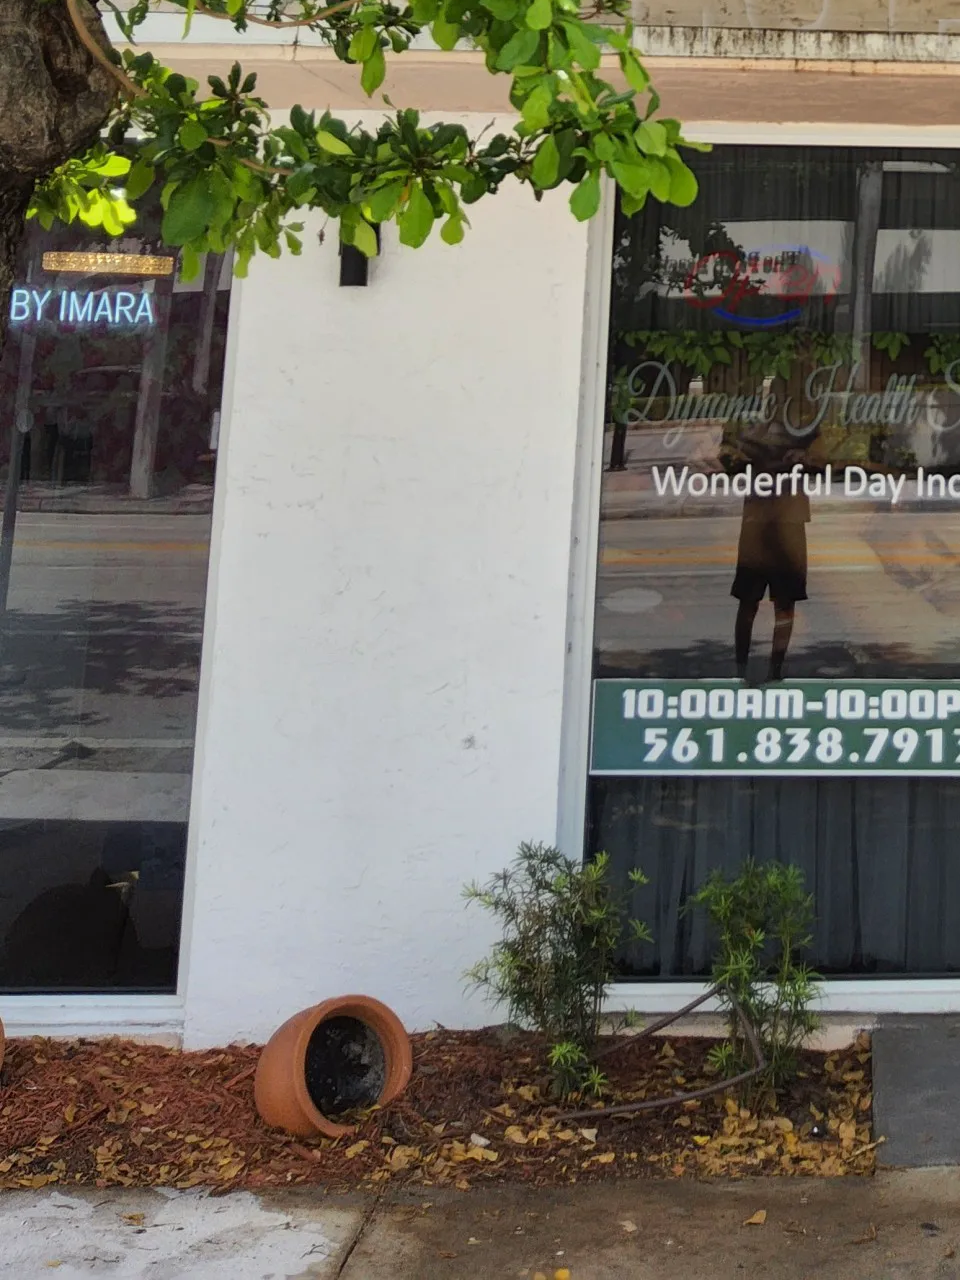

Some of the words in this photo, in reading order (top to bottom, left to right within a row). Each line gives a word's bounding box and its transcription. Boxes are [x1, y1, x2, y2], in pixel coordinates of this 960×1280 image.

[9, 288, 52, 322] BY
[59, 290, 155, 323] IMARA
[651, 463, 832, 498] Wonderful
[844, 466, 906, 504] Day
